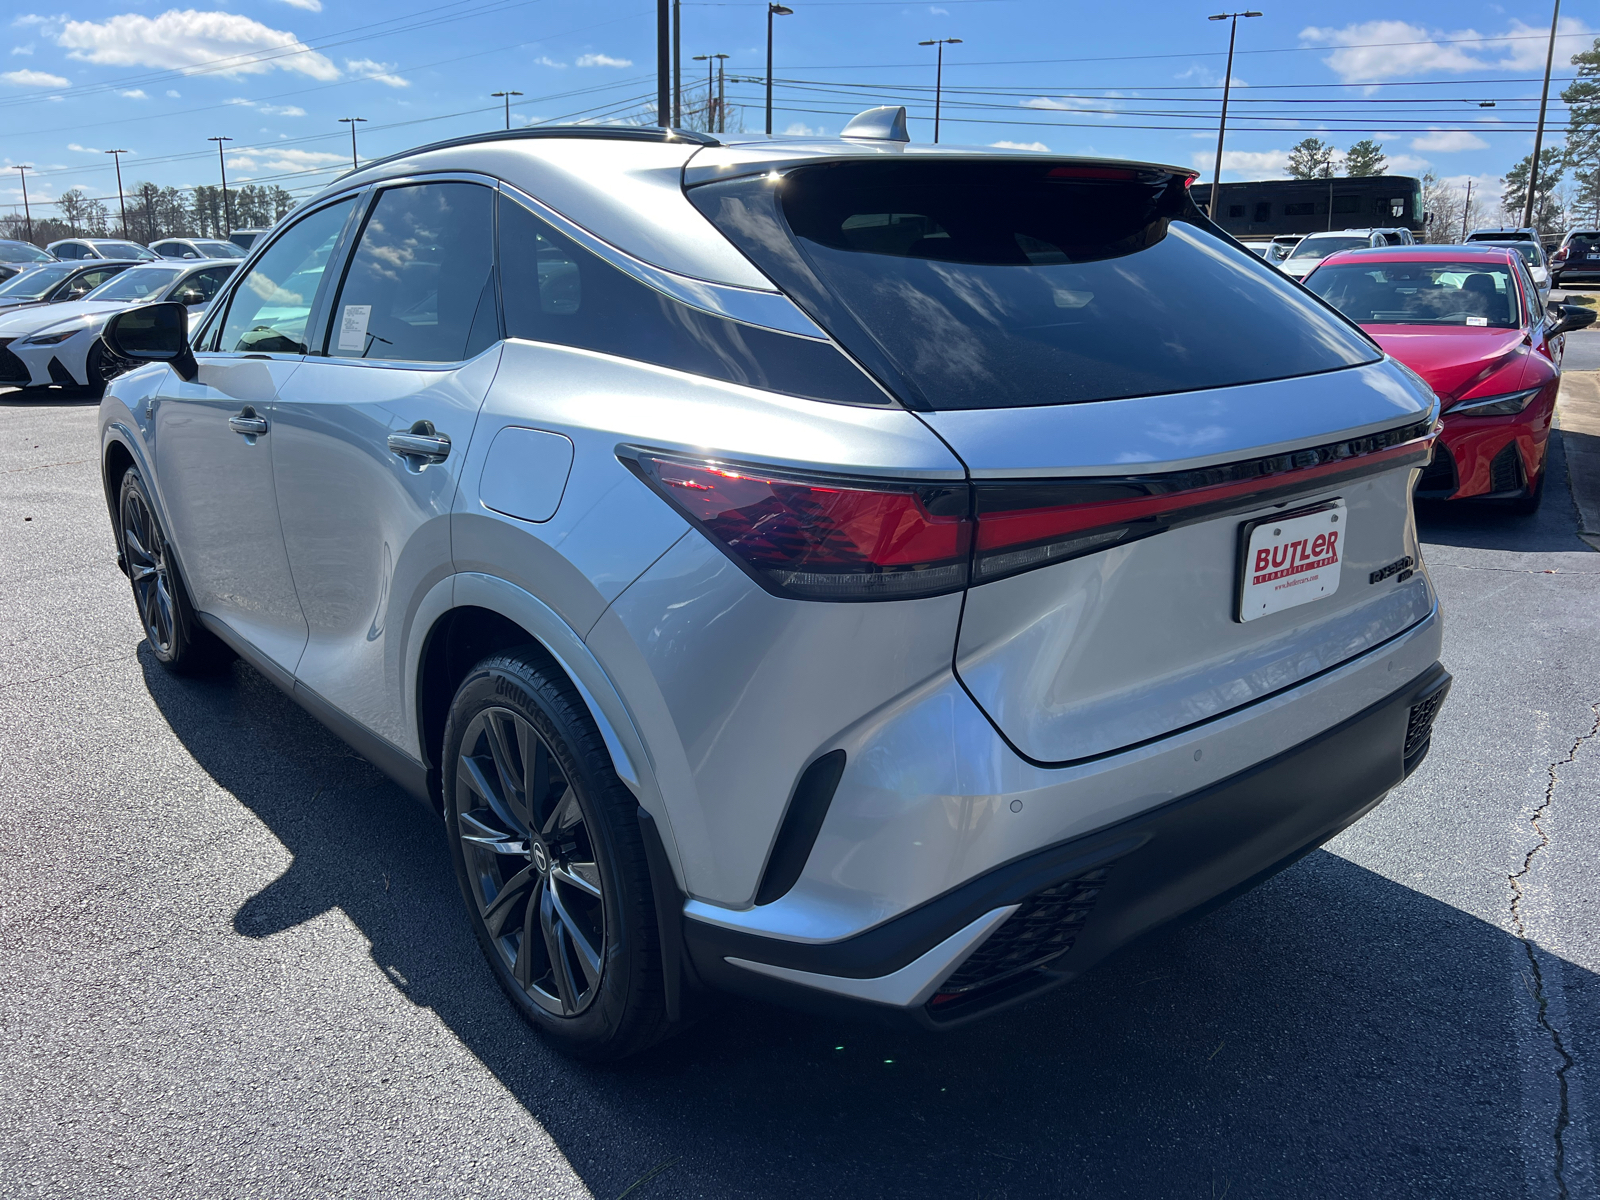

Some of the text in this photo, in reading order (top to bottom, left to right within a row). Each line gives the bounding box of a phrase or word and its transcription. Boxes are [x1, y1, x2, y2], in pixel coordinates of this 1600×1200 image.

[1254, 556, 1338, 585] AUTOMOTIVE GROUP
[1275, 574, 1319, 591] www.butlercars.com
[494, 675, 585, 786] BRIDGESTONE
